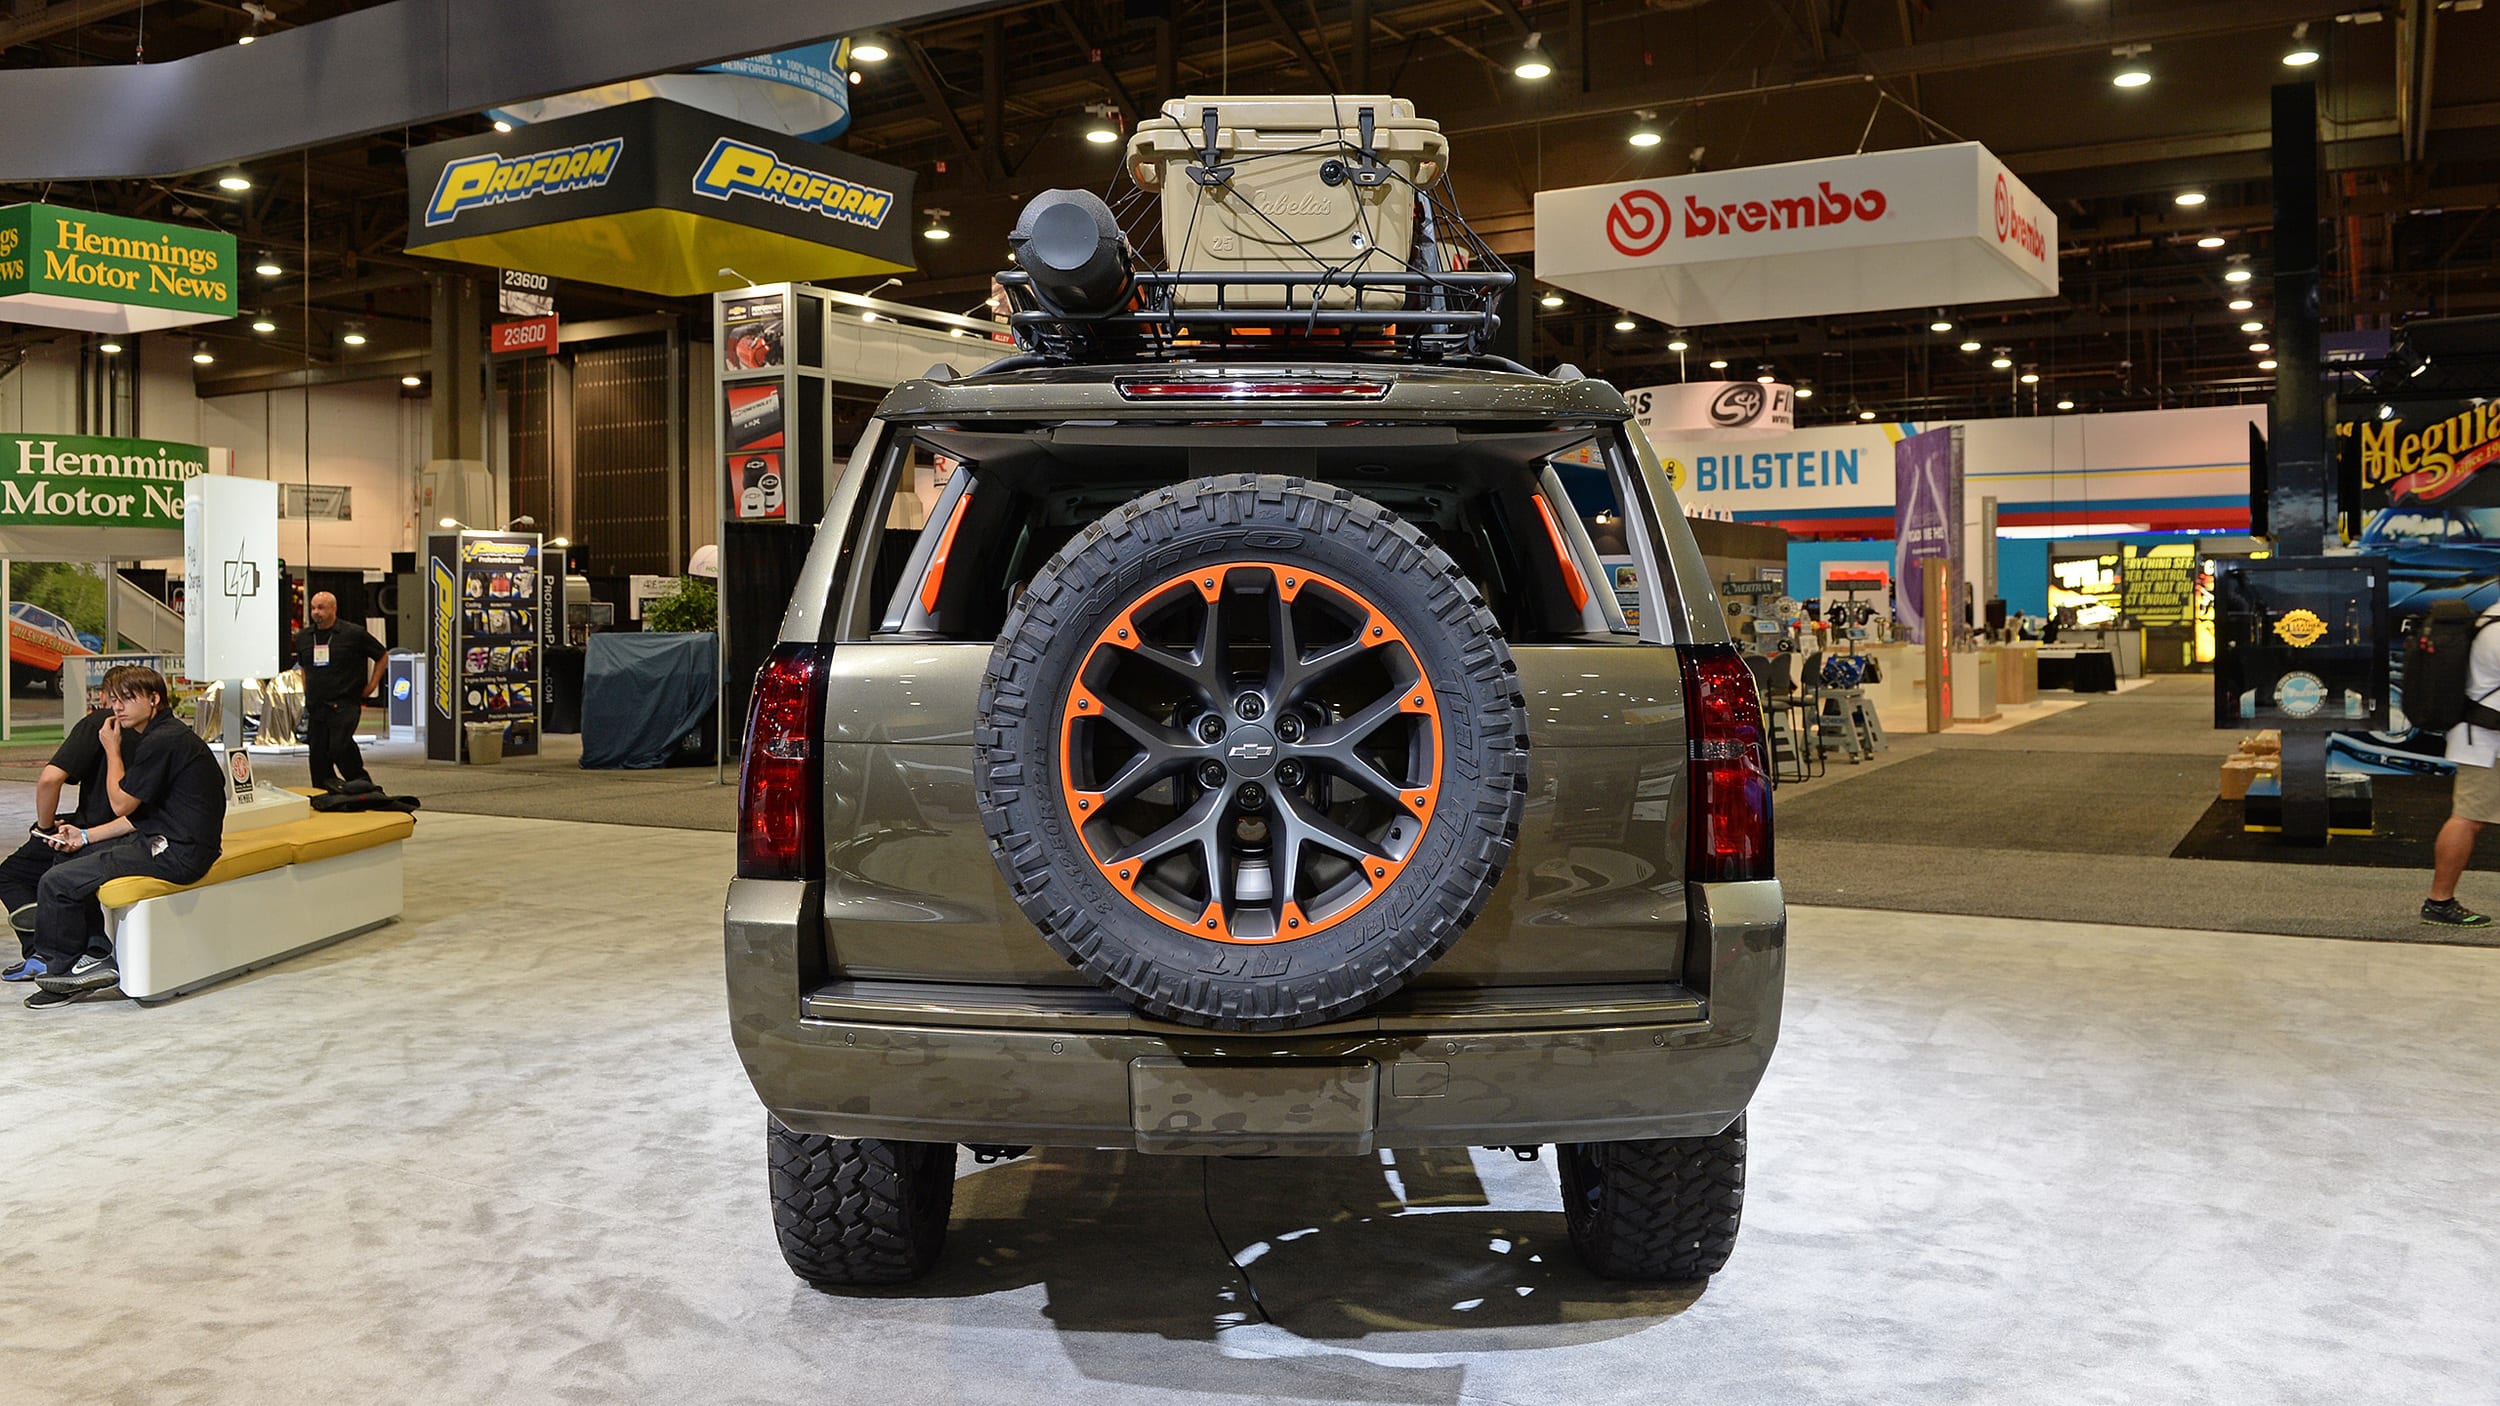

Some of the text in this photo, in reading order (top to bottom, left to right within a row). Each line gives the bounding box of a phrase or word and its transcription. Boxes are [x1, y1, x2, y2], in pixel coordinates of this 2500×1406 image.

[720, 61, 778, 76] REINFORCED
[779, 70, 800, 83] REAR
[801, 75, 815, 87] END
[427, 140, 622, 224] PROFORM
[695, 139, 892, 227] PROFORM
[1248, 189, 1332, 216] Cabela's
[1685, 181, 1887, 238] brembo
[2010, 194, 2046, 263] brembo
[56, 219, 218, 275] Hemmings
[1212, 236, 1234, 251] 25
[44, 250, 228, 302] Motor News
[505, 270, 548, 290] 23600
[504, 324, 546, 346] 23600
[15, 440, 203, 482] Hemmings
[1697, 449, 1859, 491] BILSTEIN
[2456, 453, 2484, 478] since
[1, 480, 184, 520] Motor Ne
[432, 557, 455, 719] PROFORM
